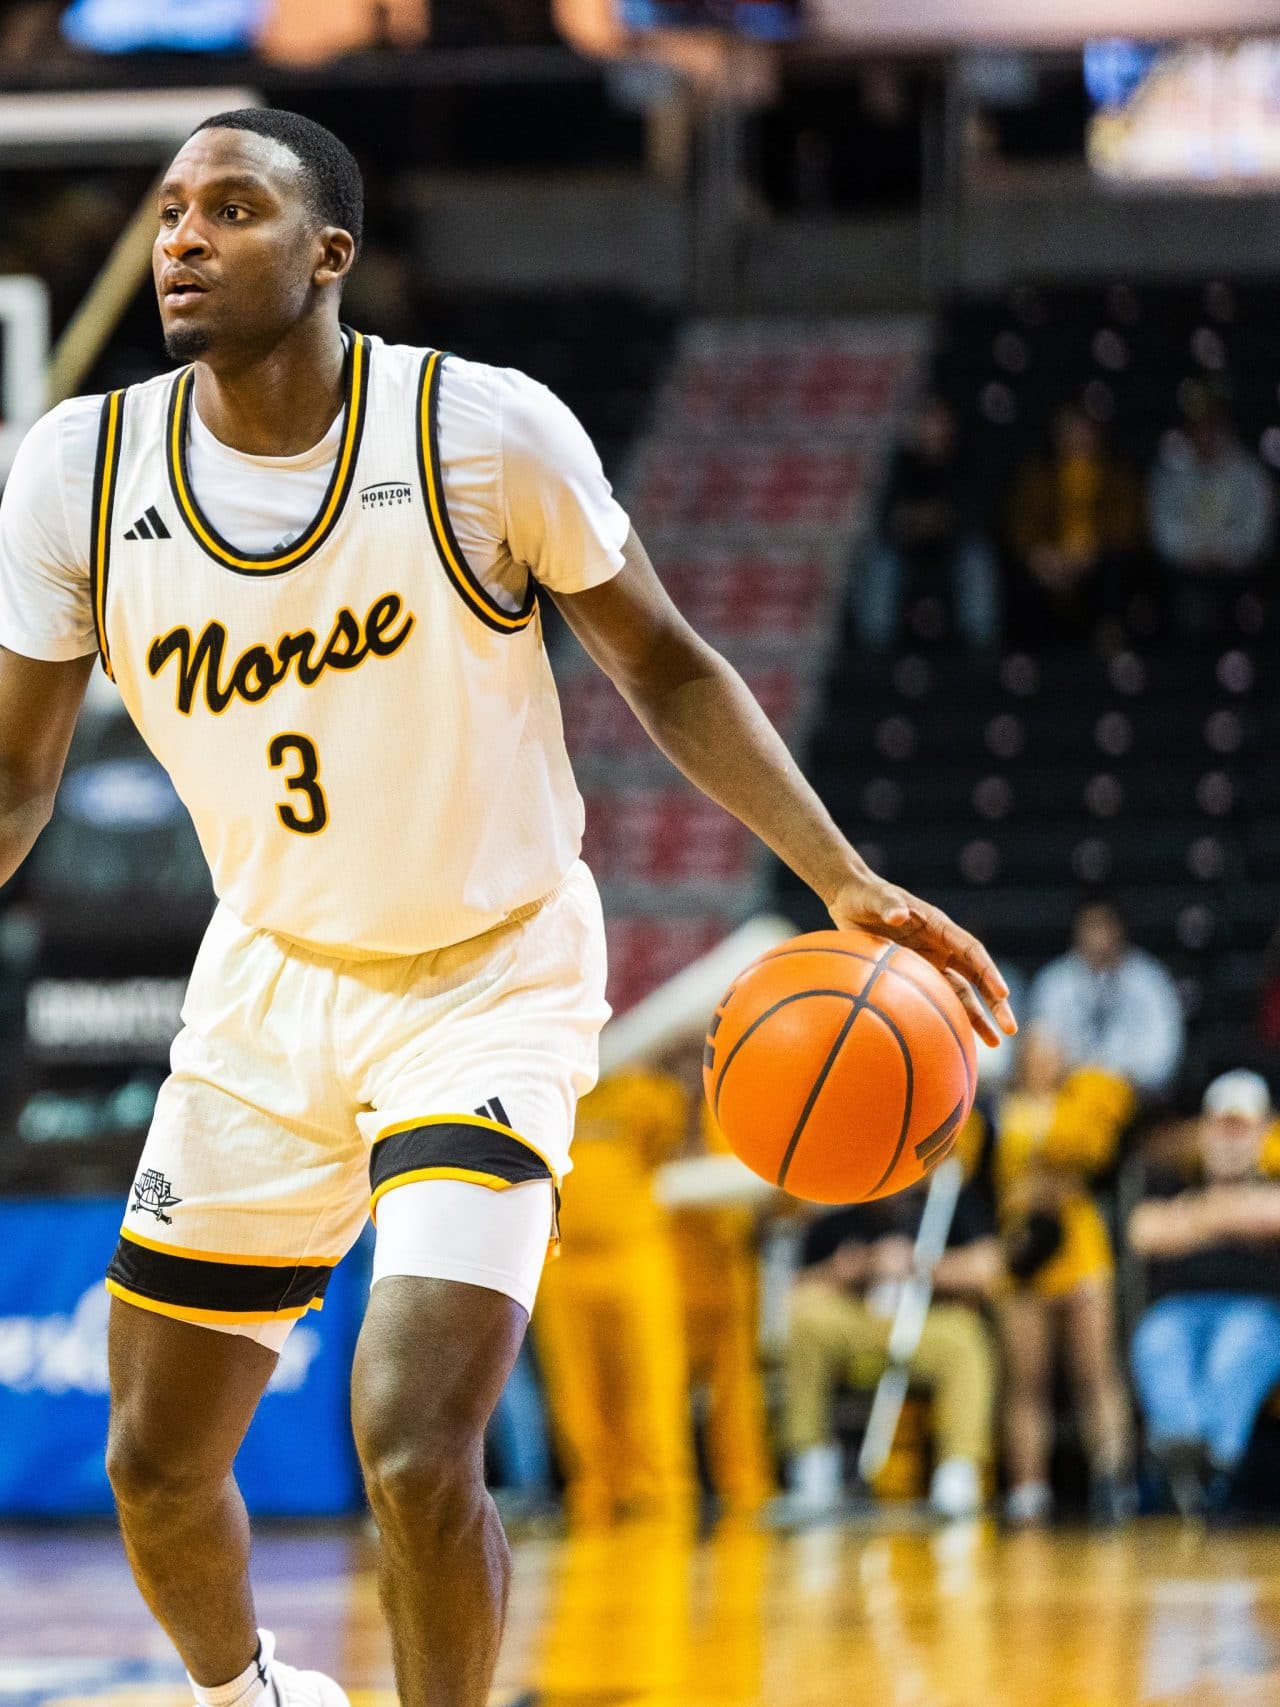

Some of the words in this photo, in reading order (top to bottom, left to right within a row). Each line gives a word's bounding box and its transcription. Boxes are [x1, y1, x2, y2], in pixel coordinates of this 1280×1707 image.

[361, 488, 411, 502] HORIZON
[362, 498, 412, 510] LEAGUE
[146, 591, 417, 717] Norse
[266, 730, 330, 836] 3
